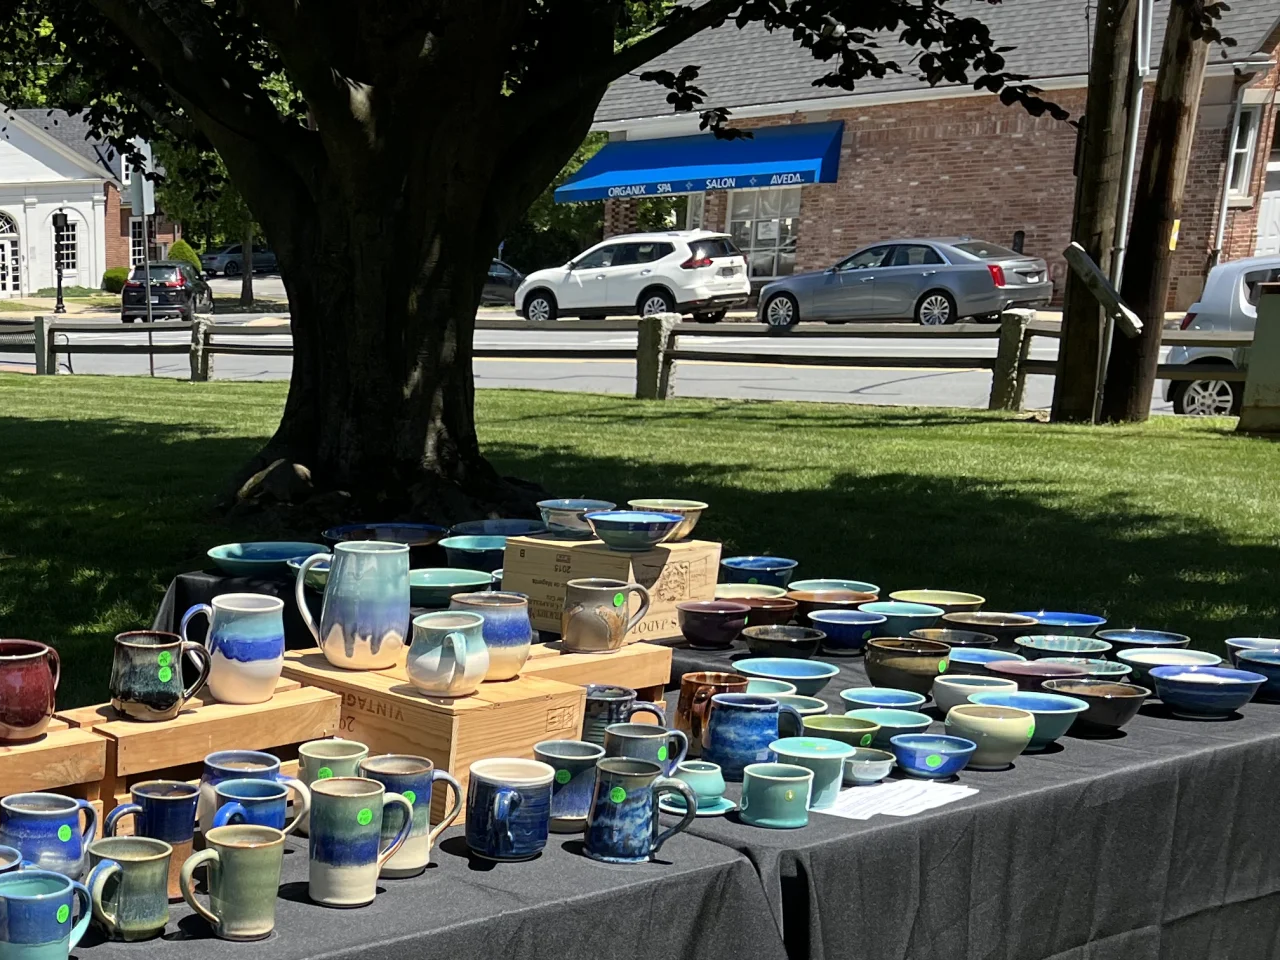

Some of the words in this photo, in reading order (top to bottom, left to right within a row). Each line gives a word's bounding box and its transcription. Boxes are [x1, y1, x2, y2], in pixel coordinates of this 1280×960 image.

[608, 184, 647, 197] ORGANIX
[656, 182, 672, 194] SPA
[705, 177, 736, 191] SALON
[770, 173, 801, 185] AVEDA
[554, 564, 571, 574] 2015
[631, 619, 668, 635] JADOT
[338, 691, 405, 722] VINTAGE
